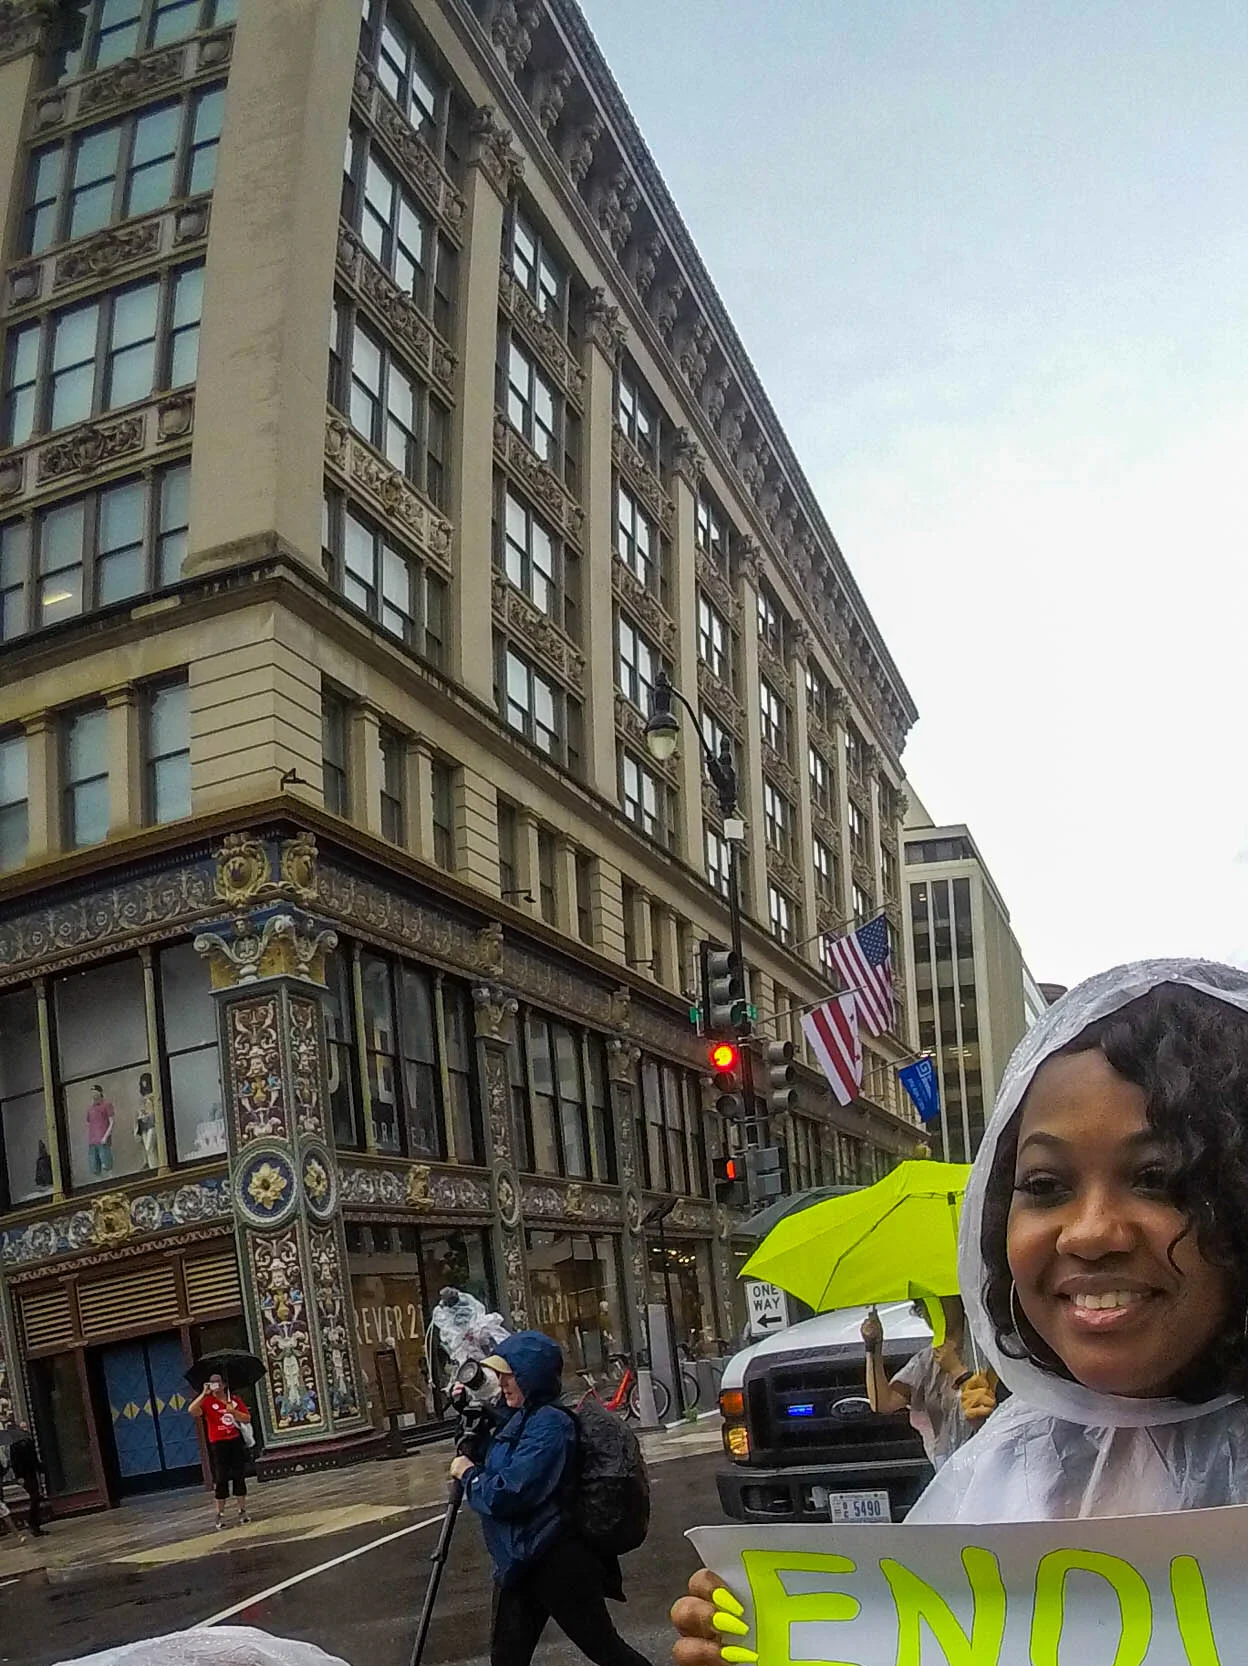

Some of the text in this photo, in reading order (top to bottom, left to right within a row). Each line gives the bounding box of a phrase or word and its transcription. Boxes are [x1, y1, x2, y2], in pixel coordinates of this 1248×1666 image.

[752, 1285, 779, 1297] ONE
[753, 1298, 780, 1311] WAY
[355, 1303, 405, 1345] REVER
[853, 1500, 881, 1516] 5490
